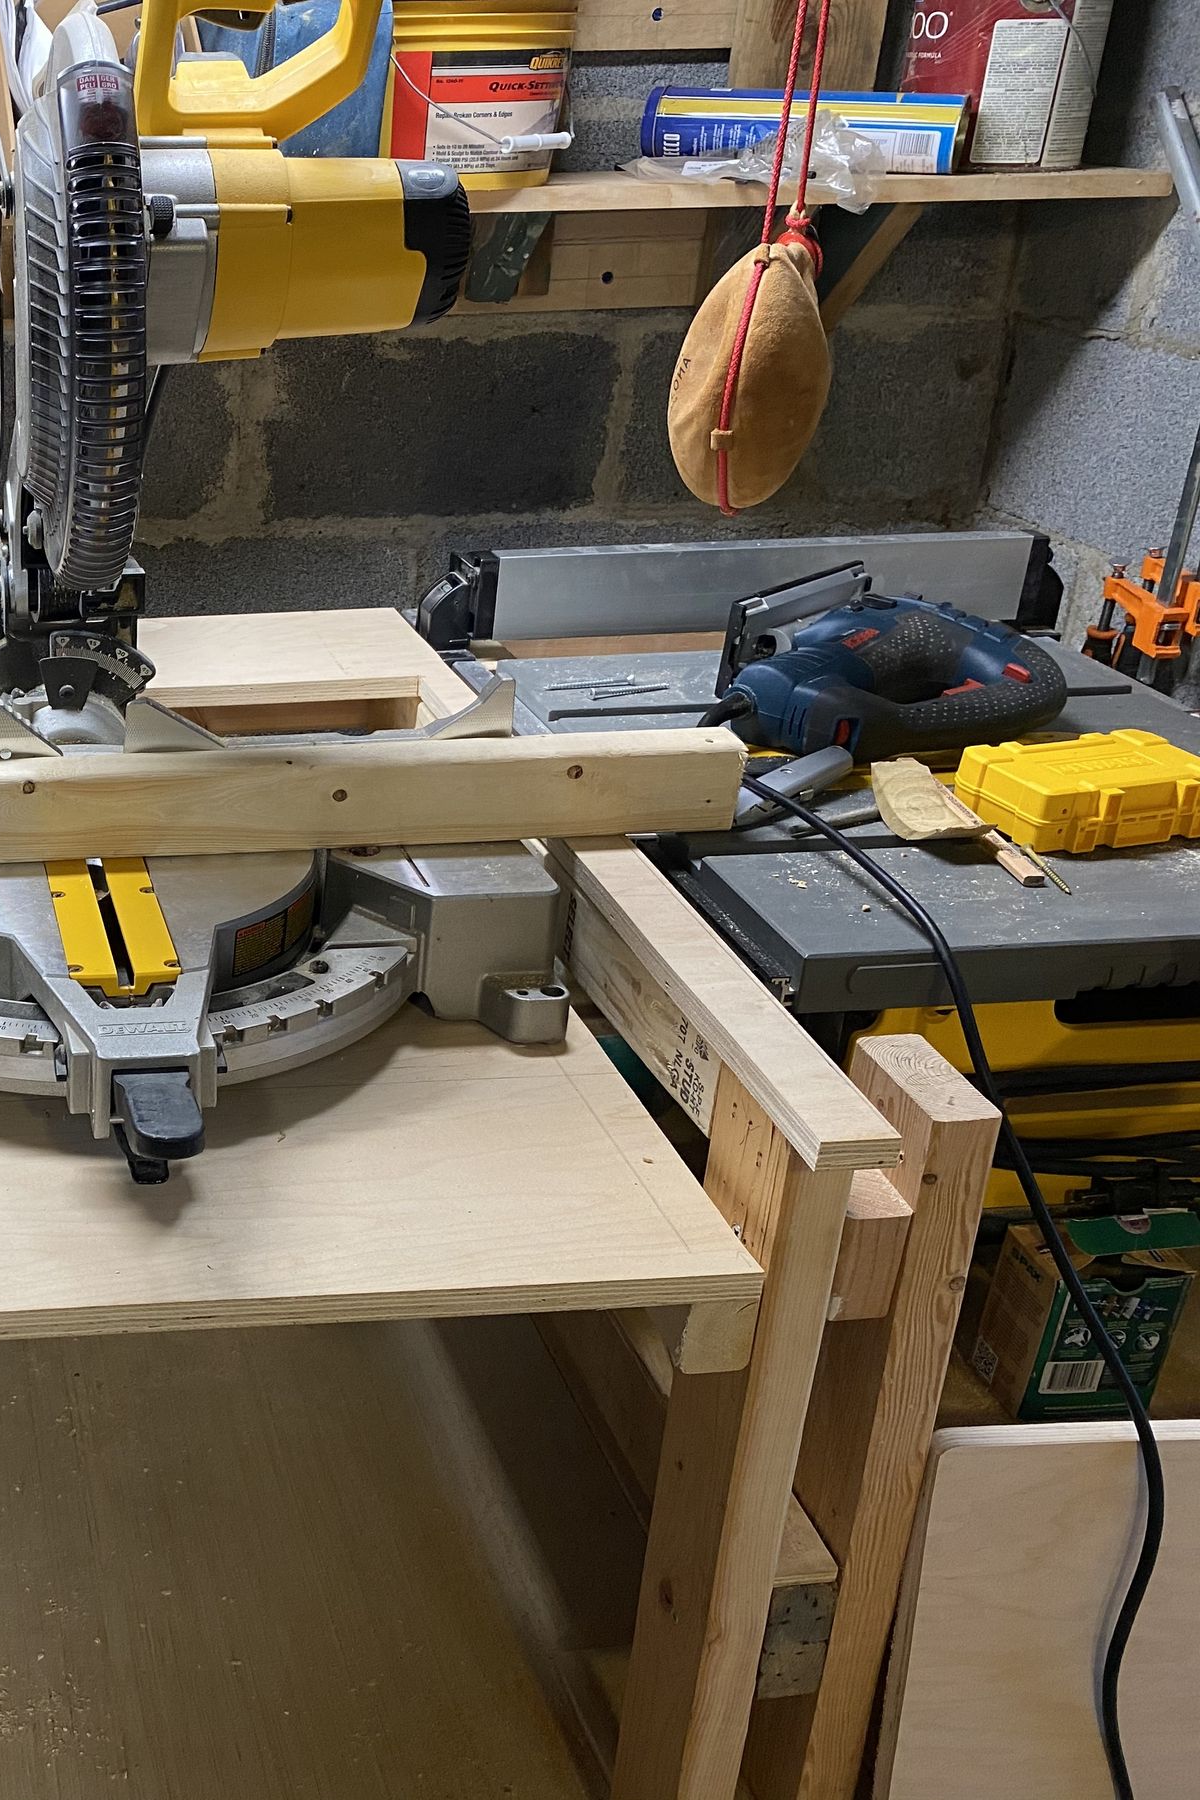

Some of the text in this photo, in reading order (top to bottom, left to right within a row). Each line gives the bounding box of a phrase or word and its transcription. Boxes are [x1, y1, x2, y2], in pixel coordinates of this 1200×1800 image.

[563, 897, 577, 962] SELECT
[98, 1022, 191, 1035] DEWALT
[680, 1058, 694, 1104] STUD
